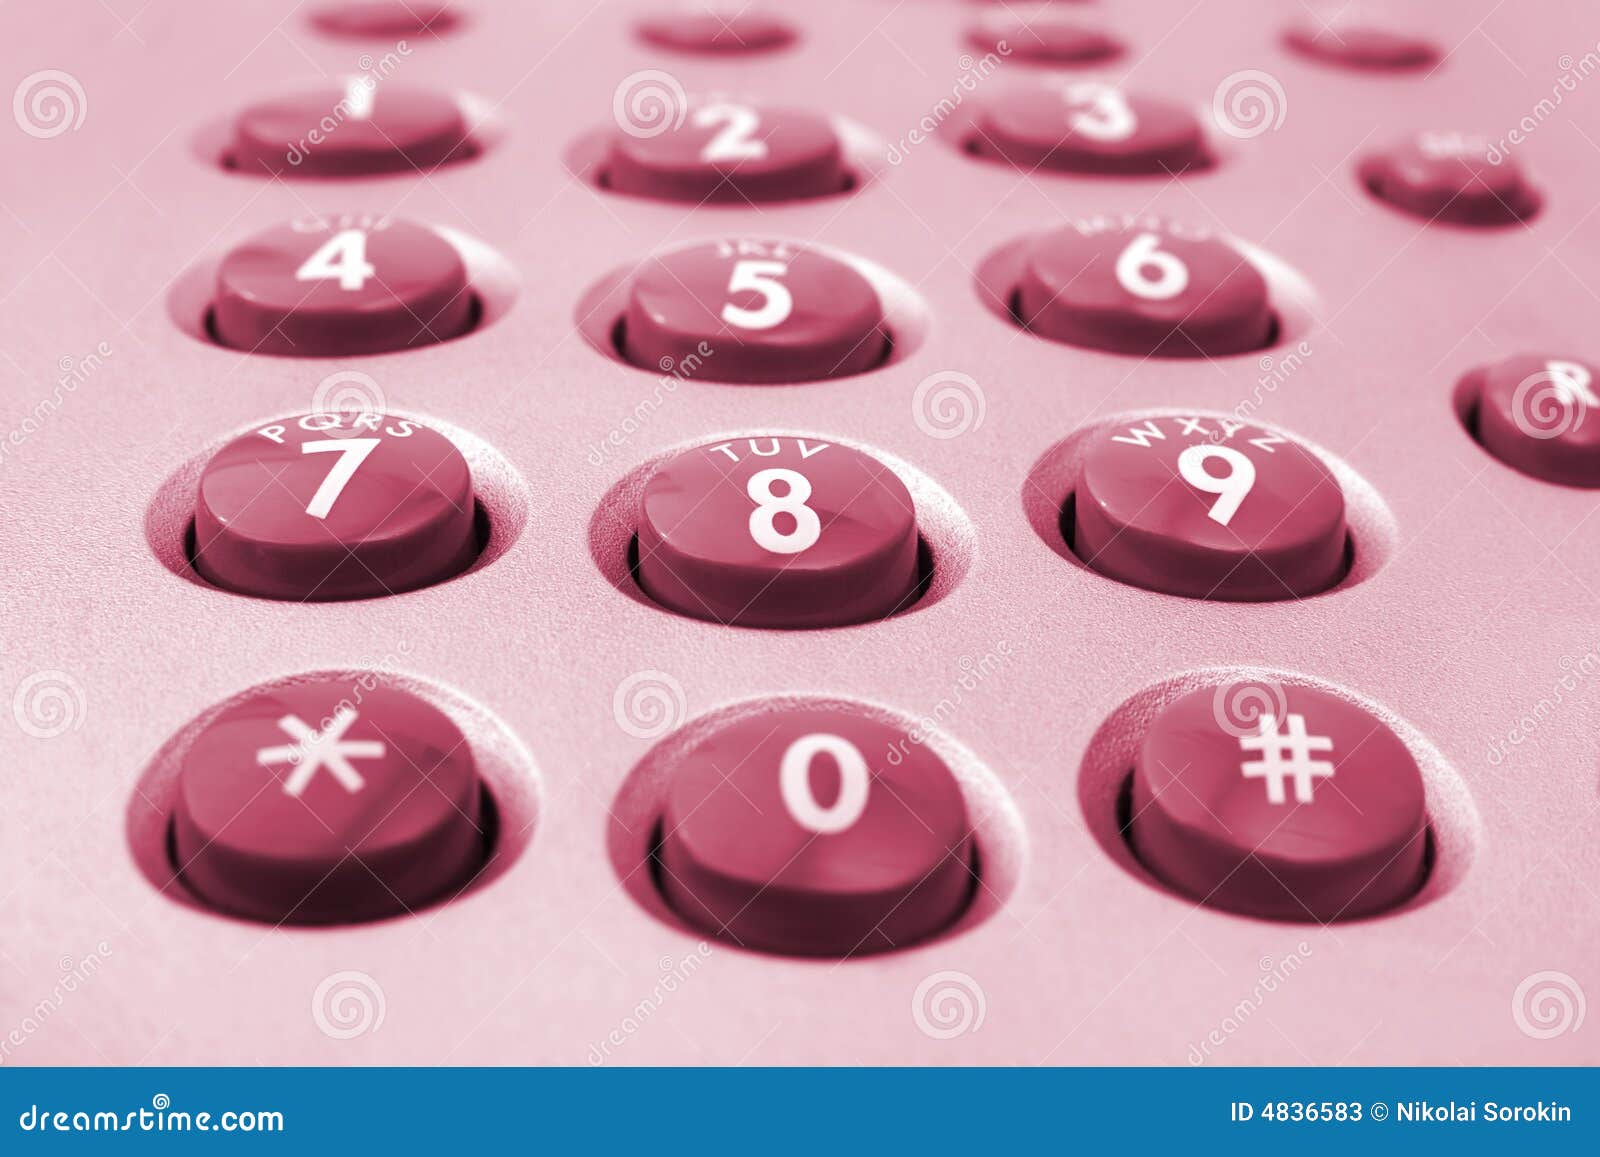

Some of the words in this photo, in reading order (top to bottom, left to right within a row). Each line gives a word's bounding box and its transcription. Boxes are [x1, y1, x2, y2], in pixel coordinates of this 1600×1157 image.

[692, 103, 769, 162] 2
[1064, 82, 1137, 140] 3
[295, 229, 375, 290] 4
[1115, 233, 1189, 299] 6
[721, 260, 793, 329] 5
[257, 413, 423, 444] PQRS
[709, 437, 830, 462] TUV
[1111, 417, 1287, 453] WXYZ
[301, 438, 382, 519] 7
[1177, 444, 1256, 527] 9
[747, 468, 821, 554] 8
[780, 733, 870, 835] 0
